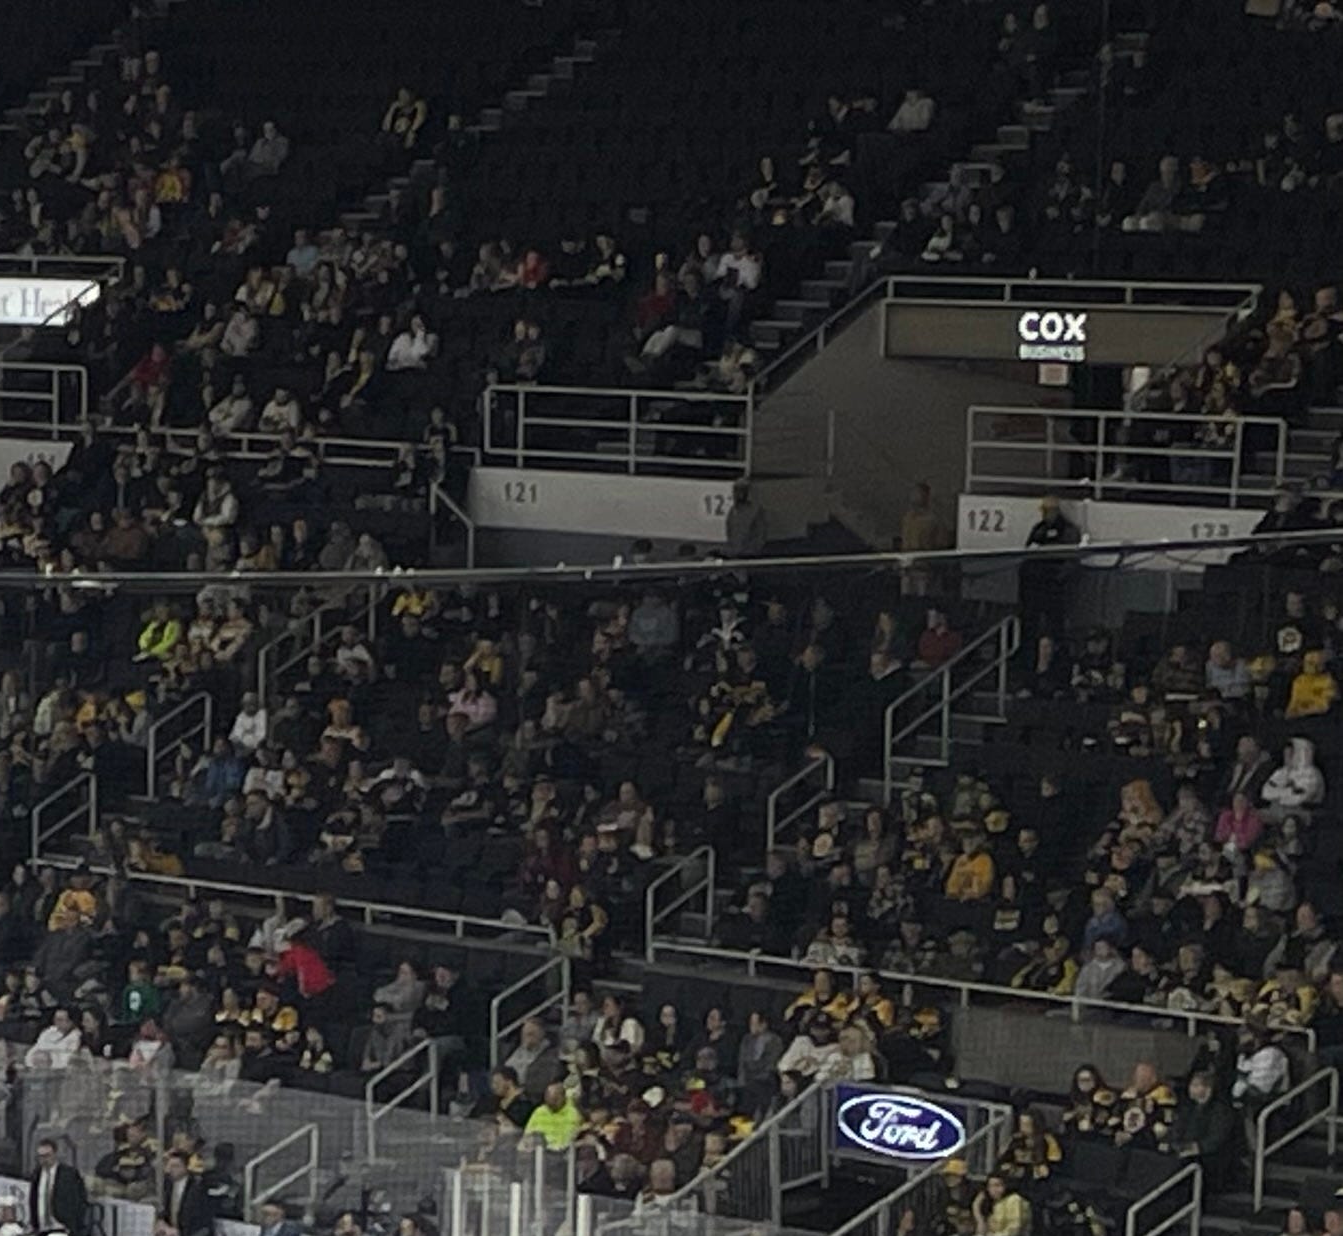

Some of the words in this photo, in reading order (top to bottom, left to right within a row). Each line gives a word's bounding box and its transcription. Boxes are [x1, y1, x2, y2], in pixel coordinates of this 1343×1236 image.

[1018, 312, 1087, 341] COX
[503, 482, 538, 505] 121
[704, 495, 733, 517] 12
[967, 509, 1005, 533] 122
